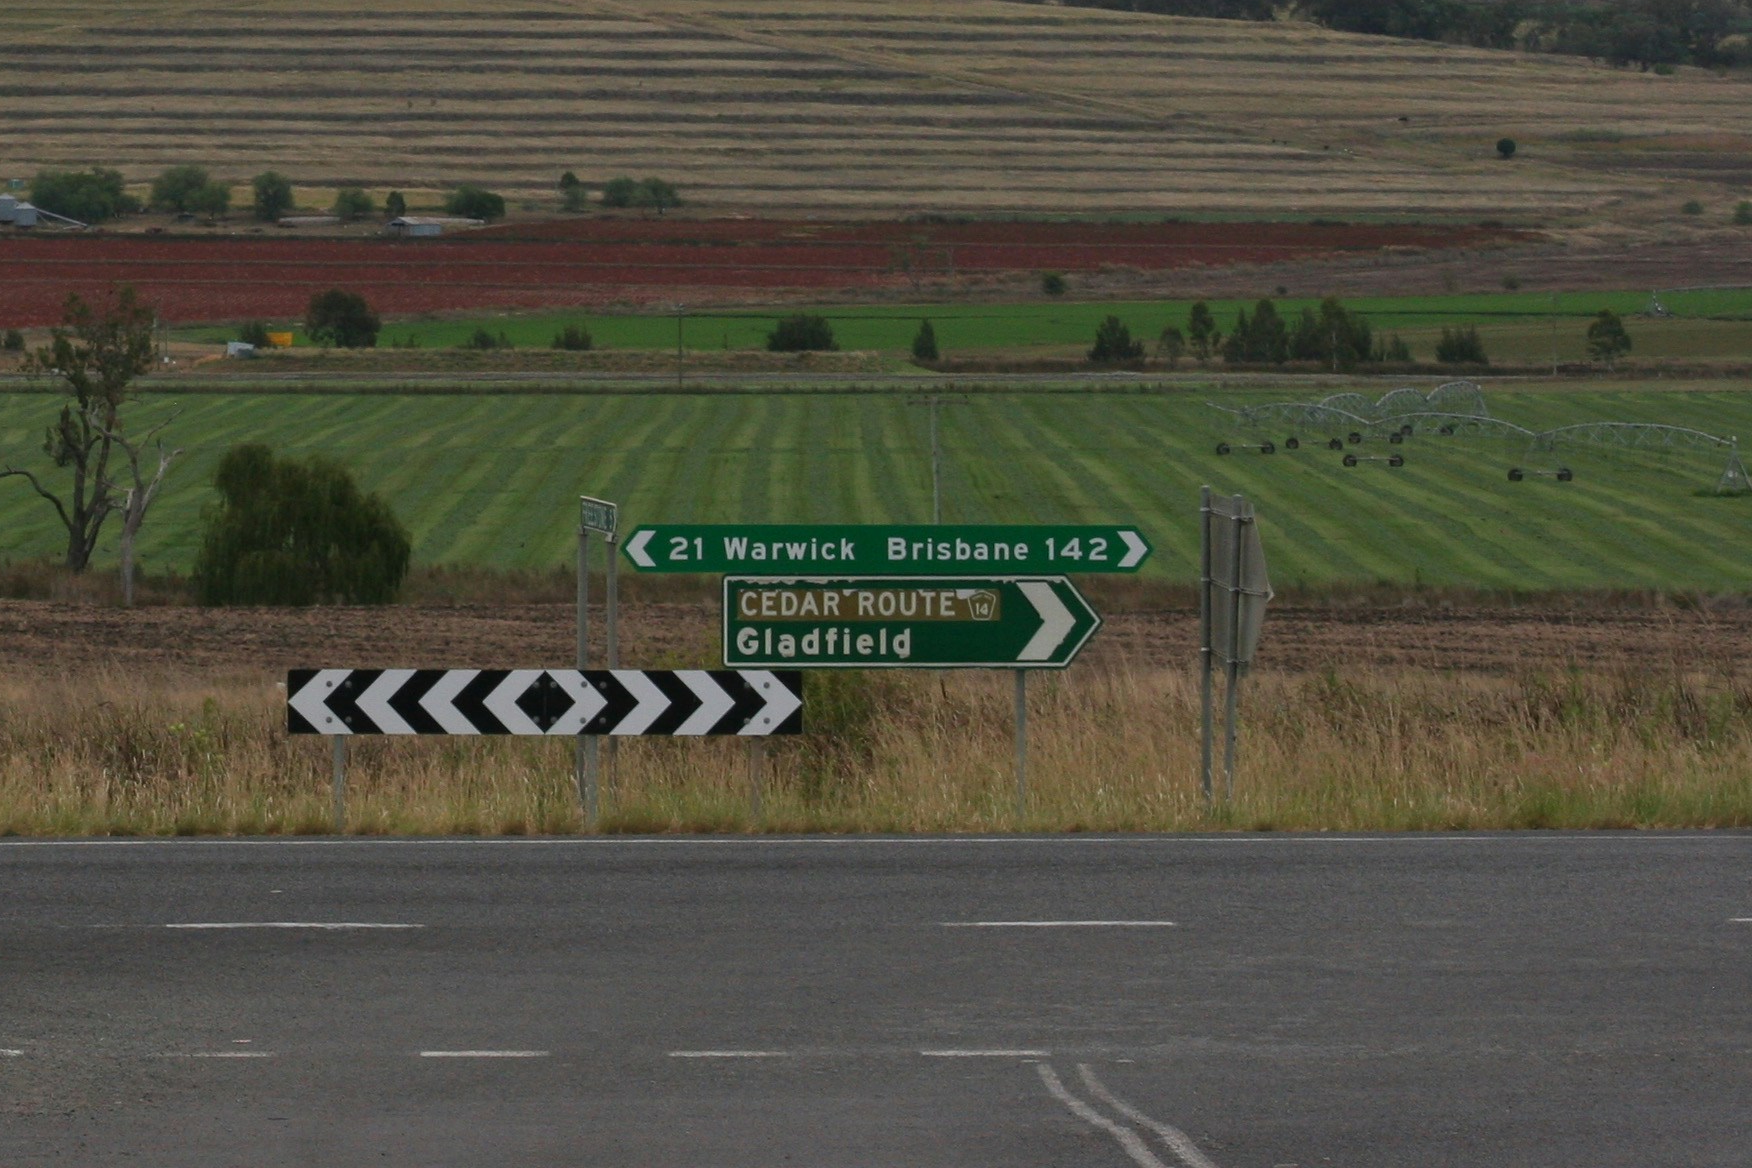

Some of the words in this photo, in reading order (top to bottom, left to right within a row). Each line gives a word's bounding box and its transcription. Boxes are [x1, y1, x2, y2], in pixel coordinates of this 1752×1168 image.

[669, 537, 703, 561] 21
[723, 537, 855, 561] Warwick
[887, 537, 1030, 561] Brisbane
[1045, 537, 1109, 561] 142
[740, 590, 841, 617] CEDAR
[857, 590, 957, 617] ROUTE
[974, 602, 990, 616] 14
[735, 627, 912, 657] Gladfield
